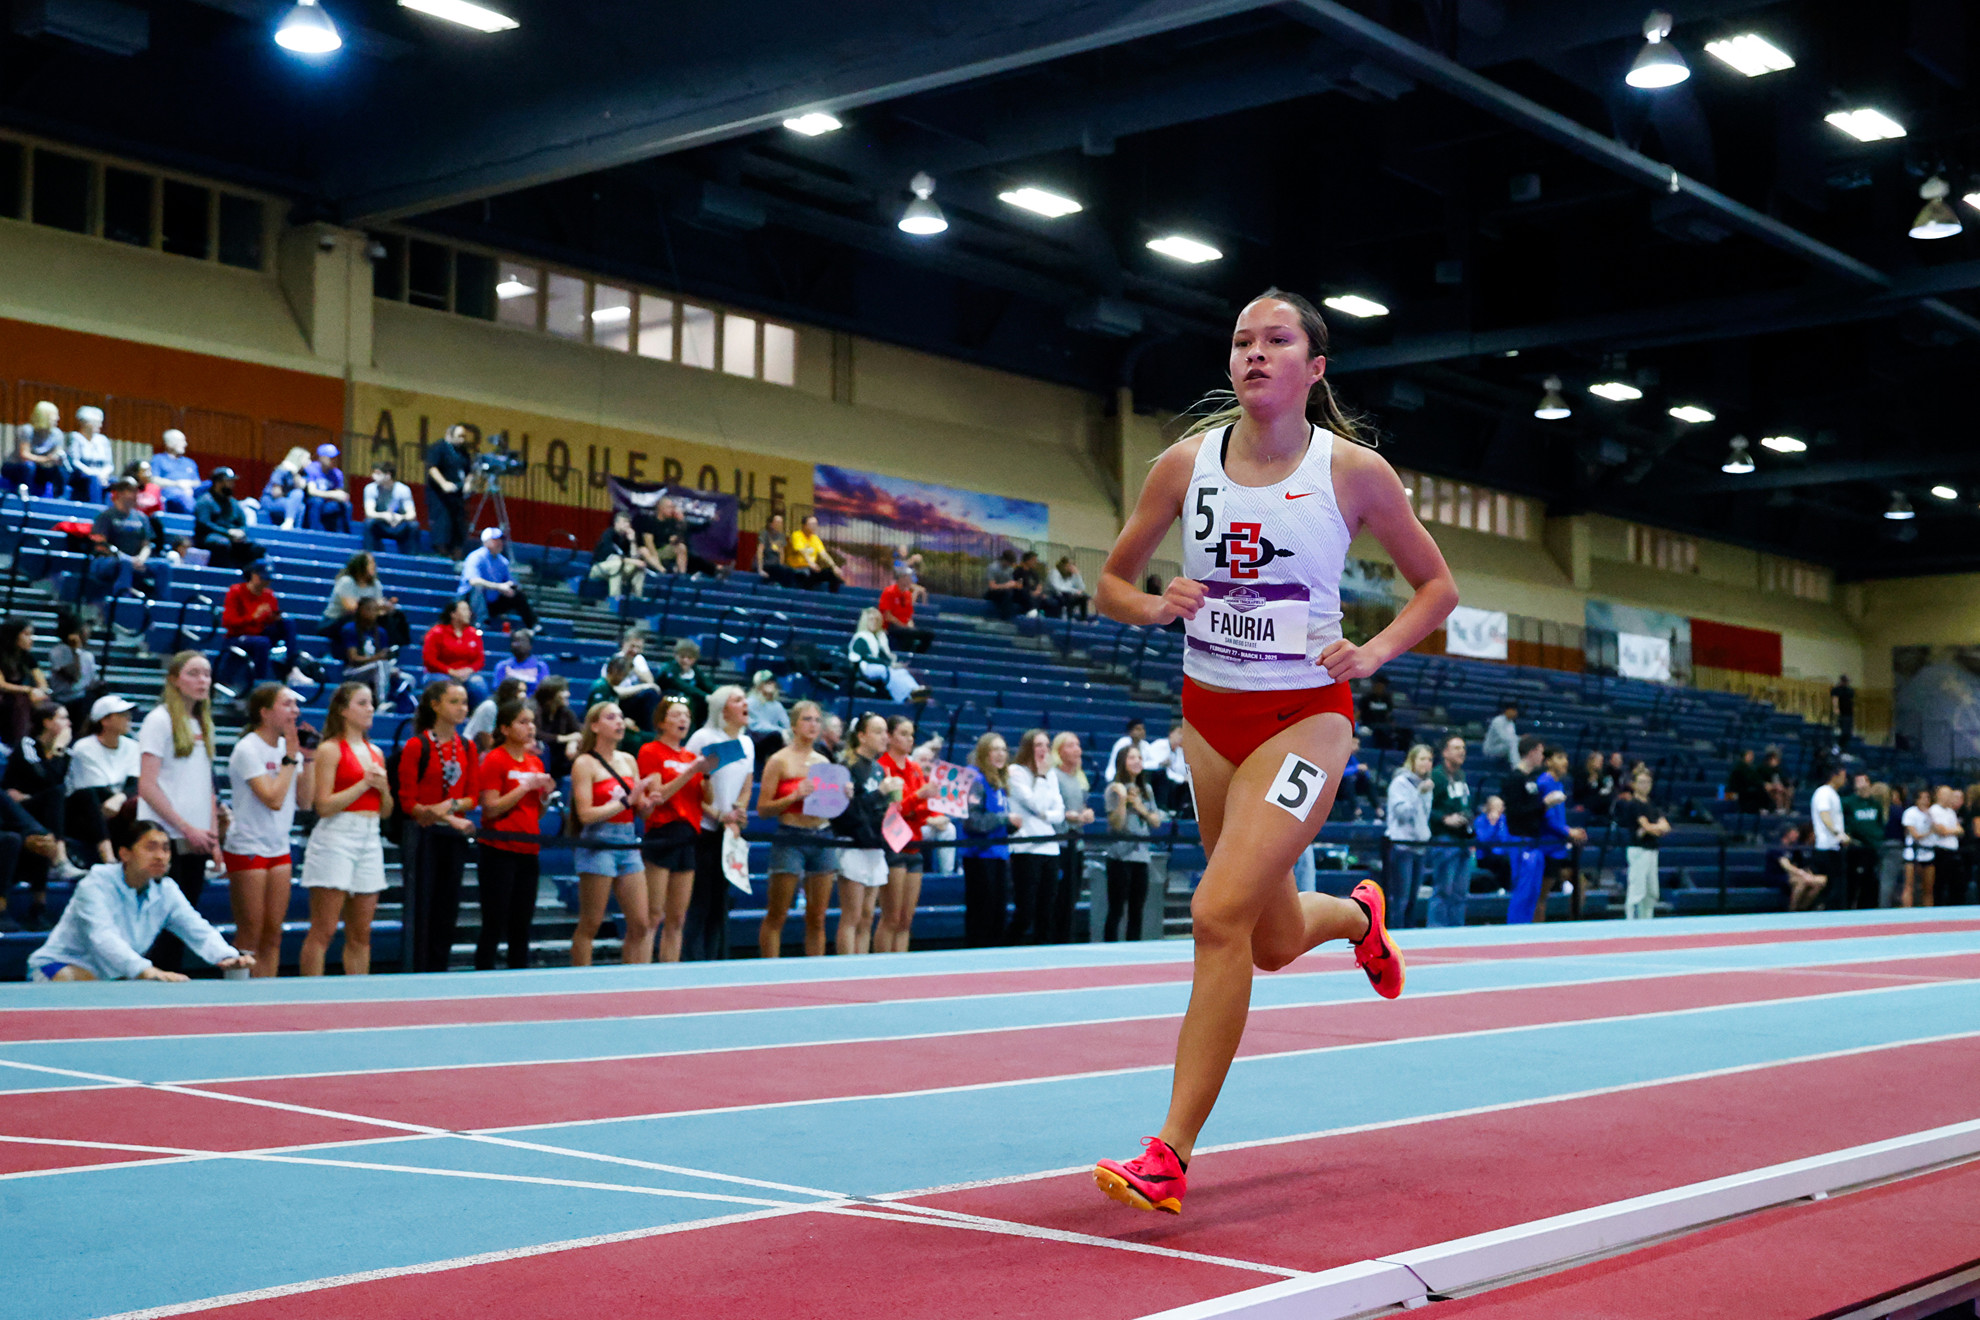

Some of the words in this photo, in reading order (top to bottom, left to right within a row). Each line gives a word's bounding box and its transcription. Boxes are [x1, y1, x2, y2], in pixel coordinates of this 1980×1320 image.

[1195, 487, 1218, 541] 5
[1211, 611, 1275, 642] FAURIA
[1209, 645, 1231, 656] FEBRUARY
[1240, 651, 1258, 659] MARCH
[1233, 639, 1244, 647] DIEGO
[1244, 641, 1257, 649] STATE
[1276, 760, 1319, 809] 5
